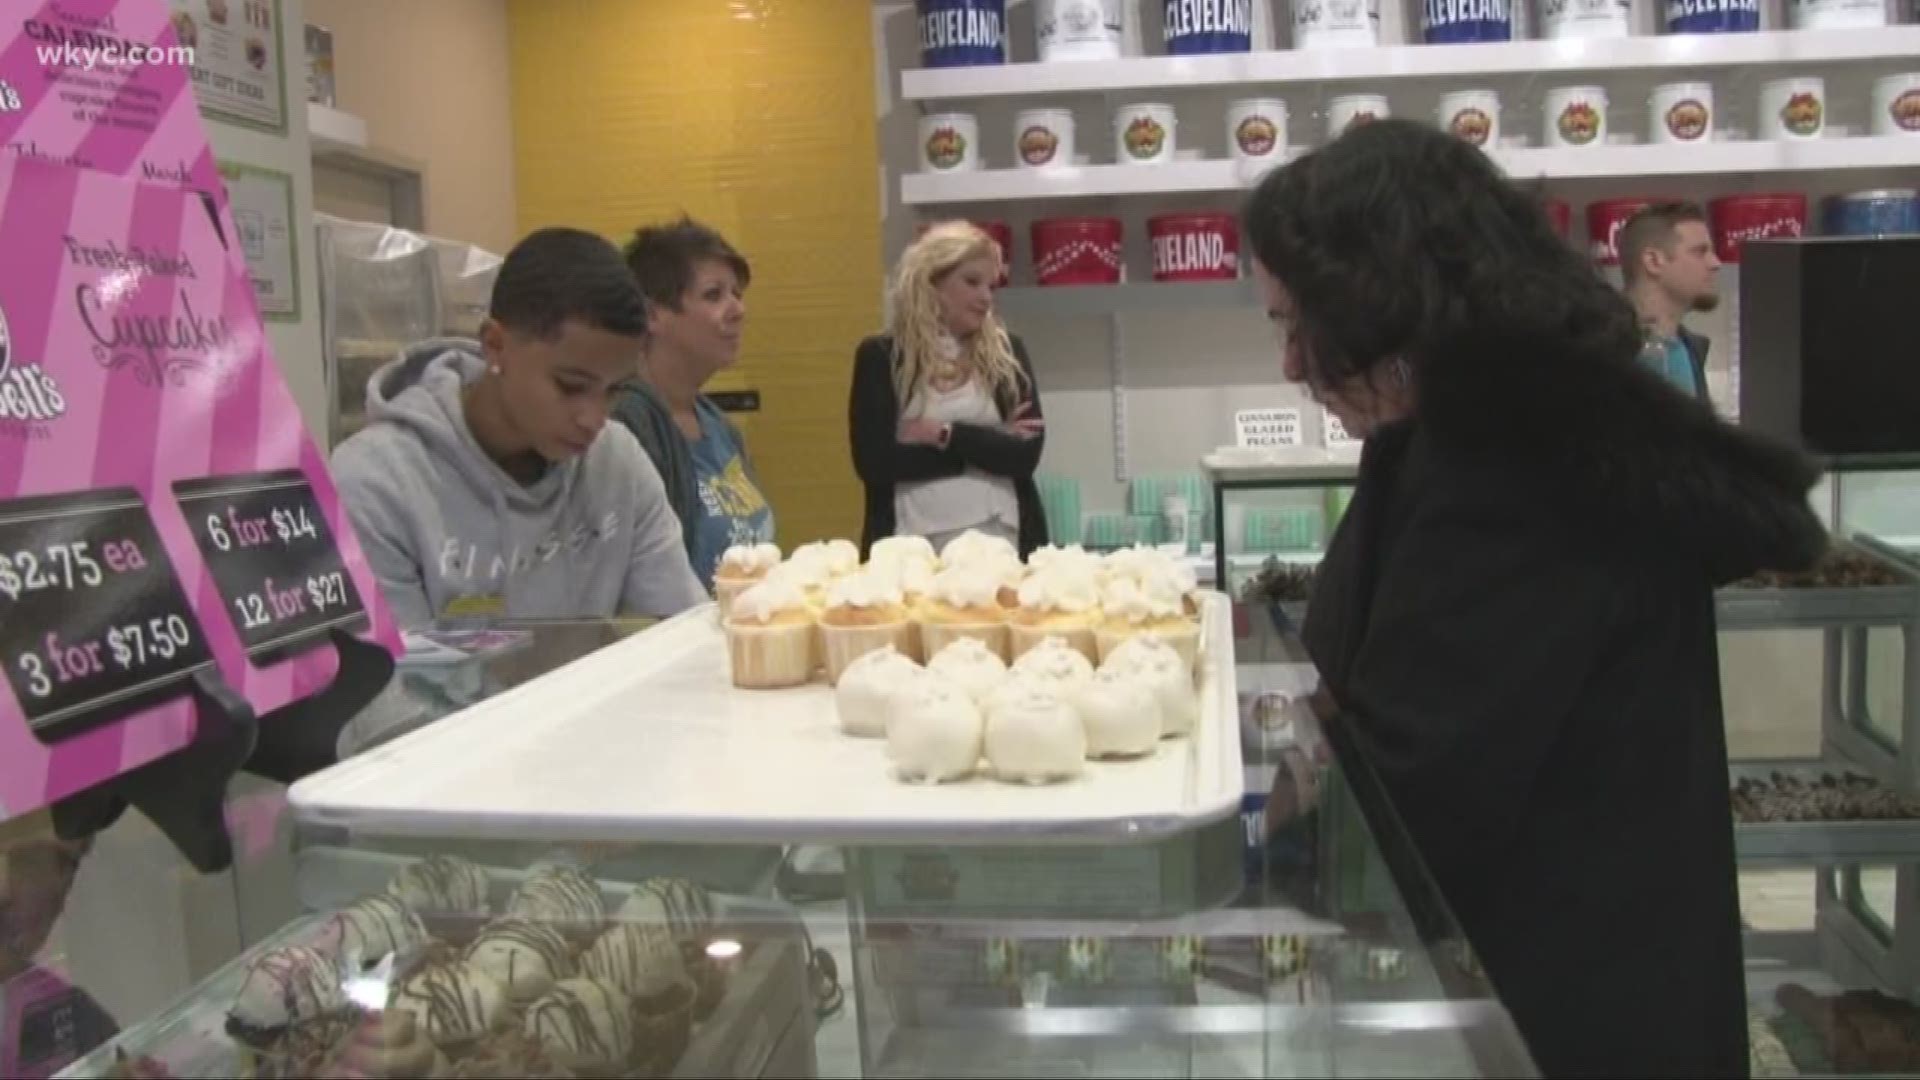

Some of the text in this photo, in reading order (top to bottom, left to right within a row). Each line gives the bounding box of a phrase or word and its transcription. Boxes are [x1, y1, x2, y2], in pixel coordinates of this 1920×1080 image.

[1244, 424, 1294, 434] GLAZED
[1247, 436, 1294, 445] PECANS
[207, 506, 316, 551] 6 for $14
[103, 539, 147, 573] ea
[235, 571, 348, 629] 12 for $27
[19, 614, 190, 698] 3 for $7.50
